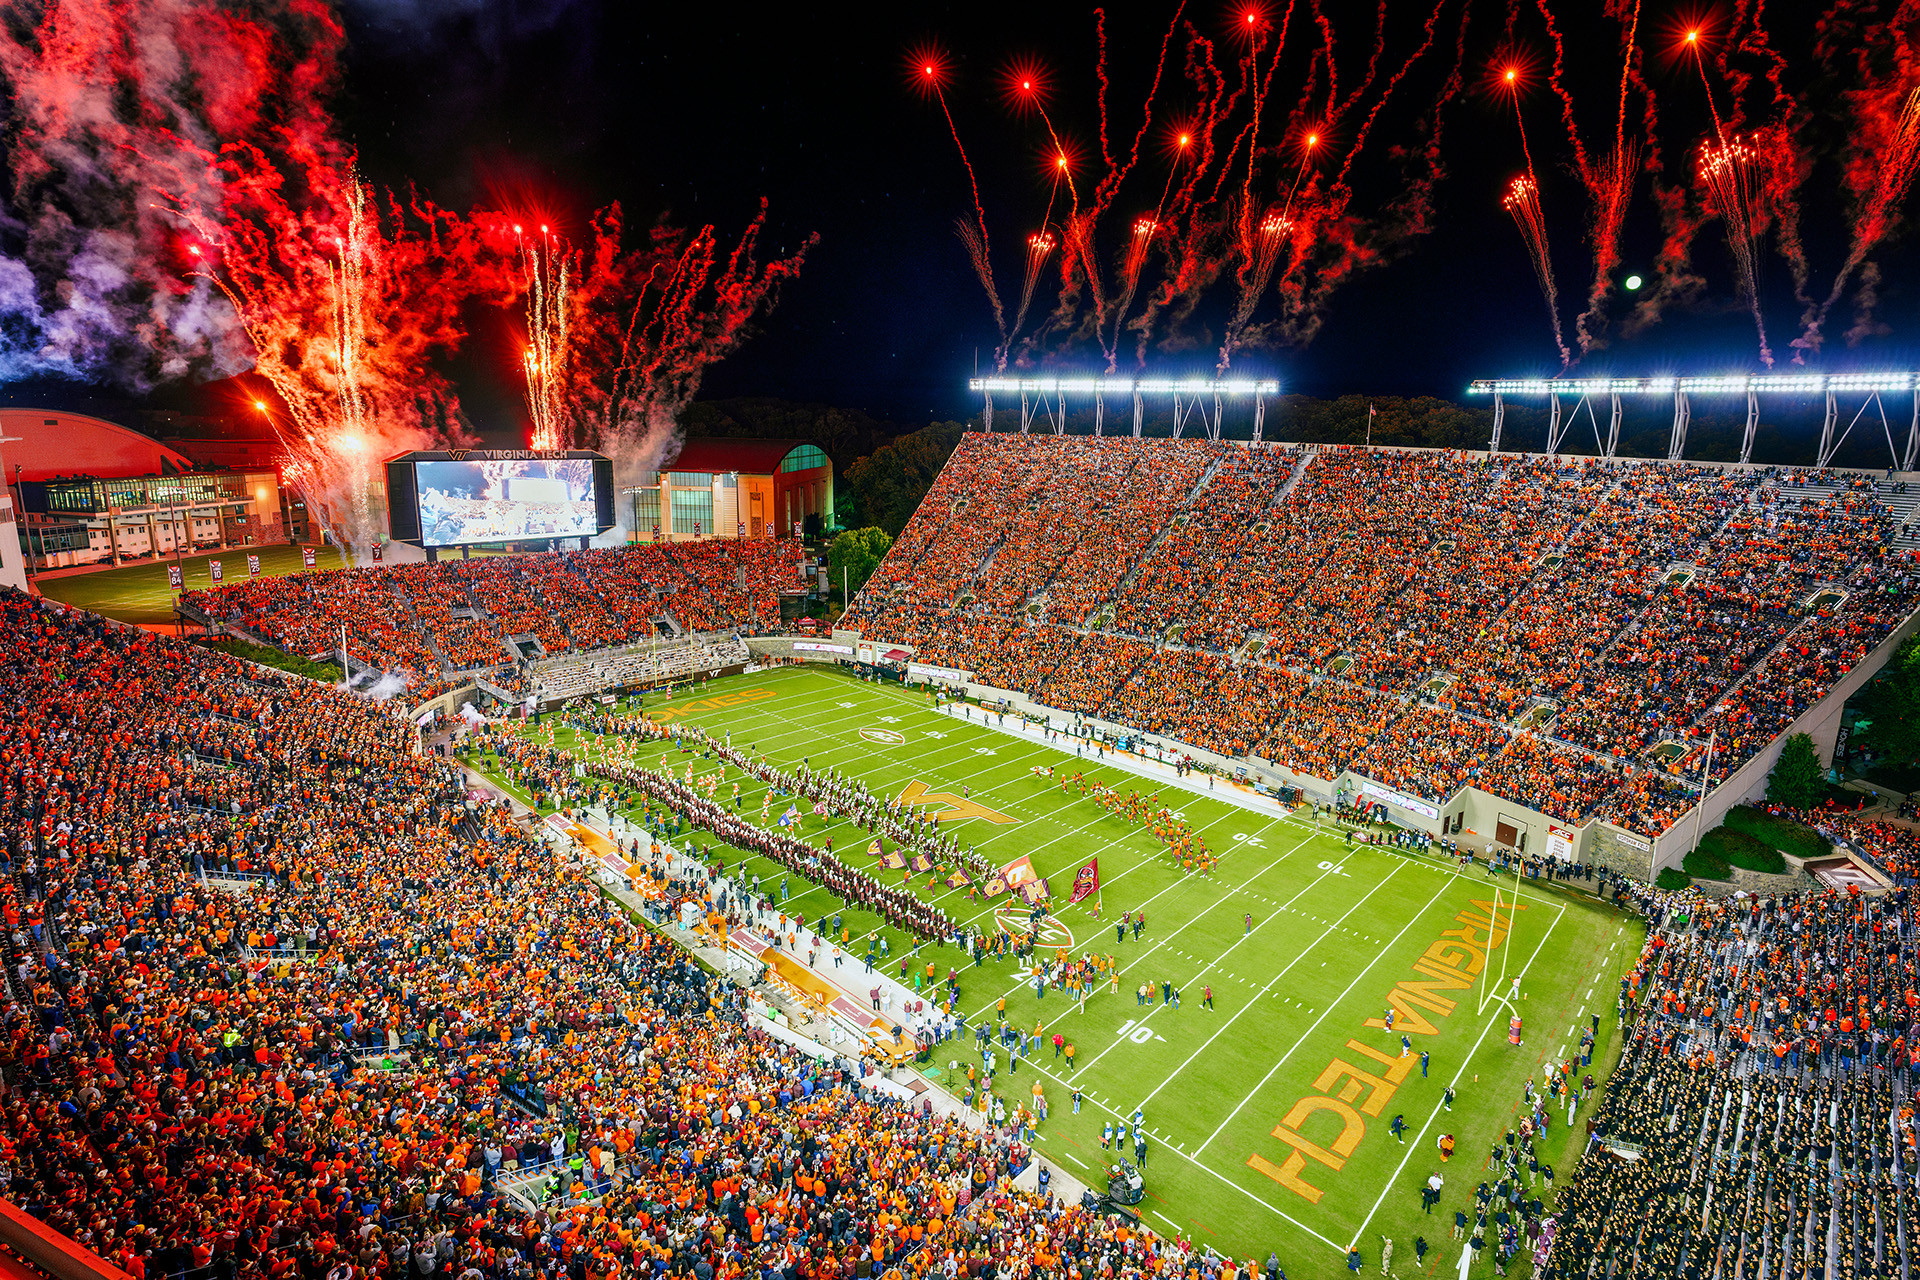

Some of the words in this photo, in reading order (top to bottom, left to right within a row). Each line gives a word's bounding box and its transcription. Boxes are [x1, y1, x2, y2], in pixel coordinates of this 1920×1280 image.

[483, 450, 537, 459] VIRGINIA
[540, 450, 567, 459] TECH
[251, 564, 260, 572] 25
[213, 570, 222, 579] 10
[171, 576, 182, 585] 84
[709, 669, 721, 677] VT
[1551, 828, 1572, 839] ACC
[1362, 899, 1529, 1035] VIRGINIA
[1116, 1019, 1154, 1044] 10
[1245, 1038, 1422, 1205] TECH
